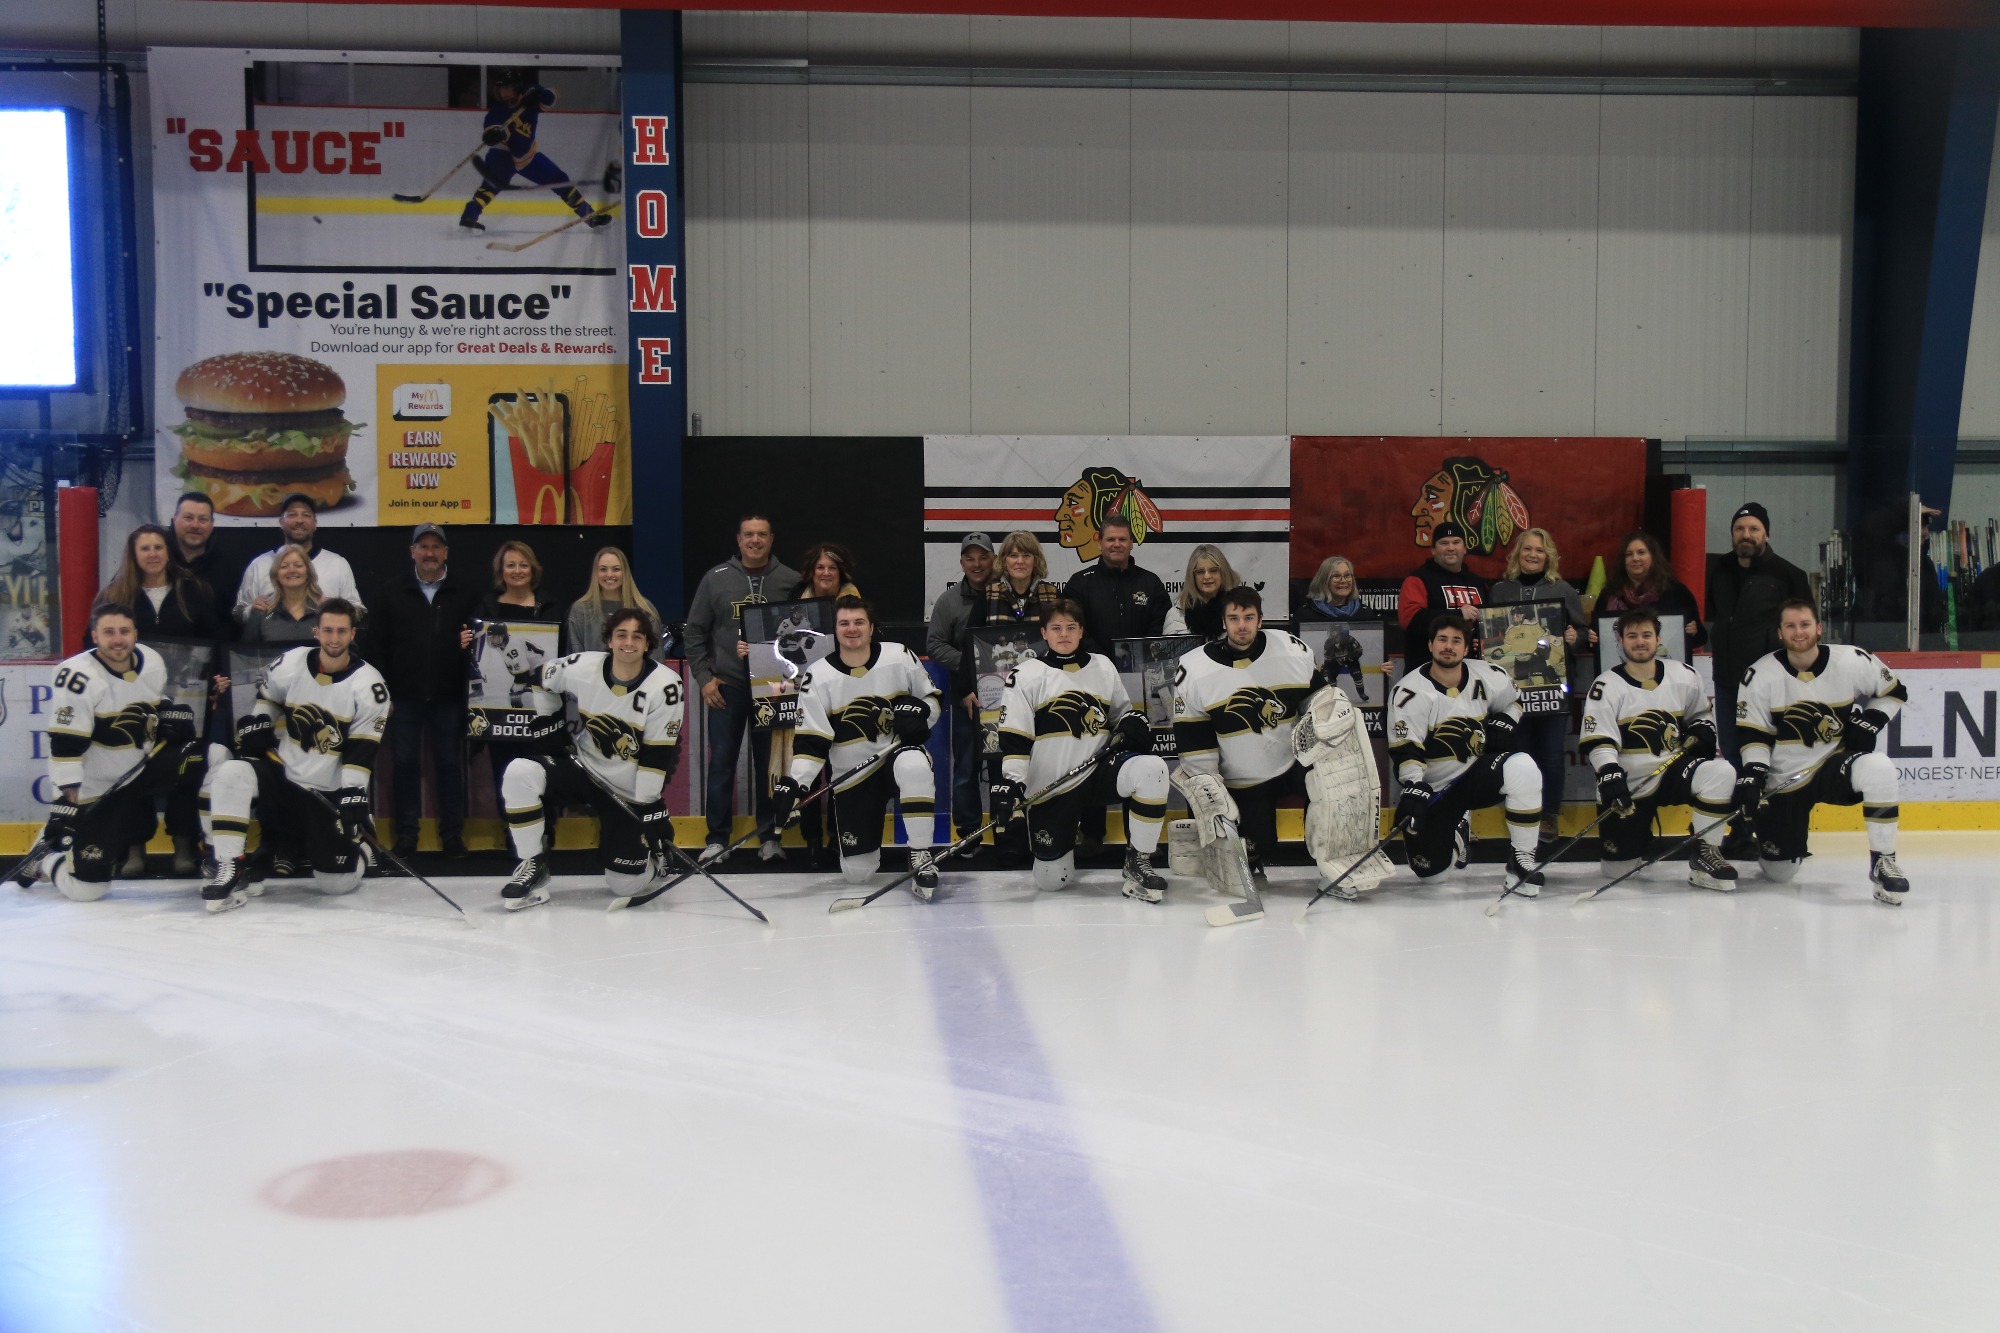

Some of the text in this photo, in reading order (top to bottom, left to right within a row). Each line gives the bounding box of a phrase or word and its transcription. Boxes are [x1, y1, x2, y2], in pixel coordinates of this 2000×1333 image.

[167, 118, 404, 174] "SAUCE"
[629, 116, 676, 384] HOME
[204, 281, 571, 328] "Special Sauce"
[331, 323, 616, 339] You're hungy & we're right across the street.
[311, 341, 617, 356] Download our app for Great Deals & Rewards.
[411, 392, 425, 401] My
[408, 402, 444, 410] Rewards
[404, 431, 442, 447] EARN
[389, 452, 457, 468] REWARDS
[406, 473, 440, 489] NOW
[388, 499, 410, 507] Join
[411, 499, 420, 507] in
[440, 500, 459, 510] App
[54, 667, 90, 695] 86
[1472, 679, 1487, 701] A
[632, 690, 647, 714] C
